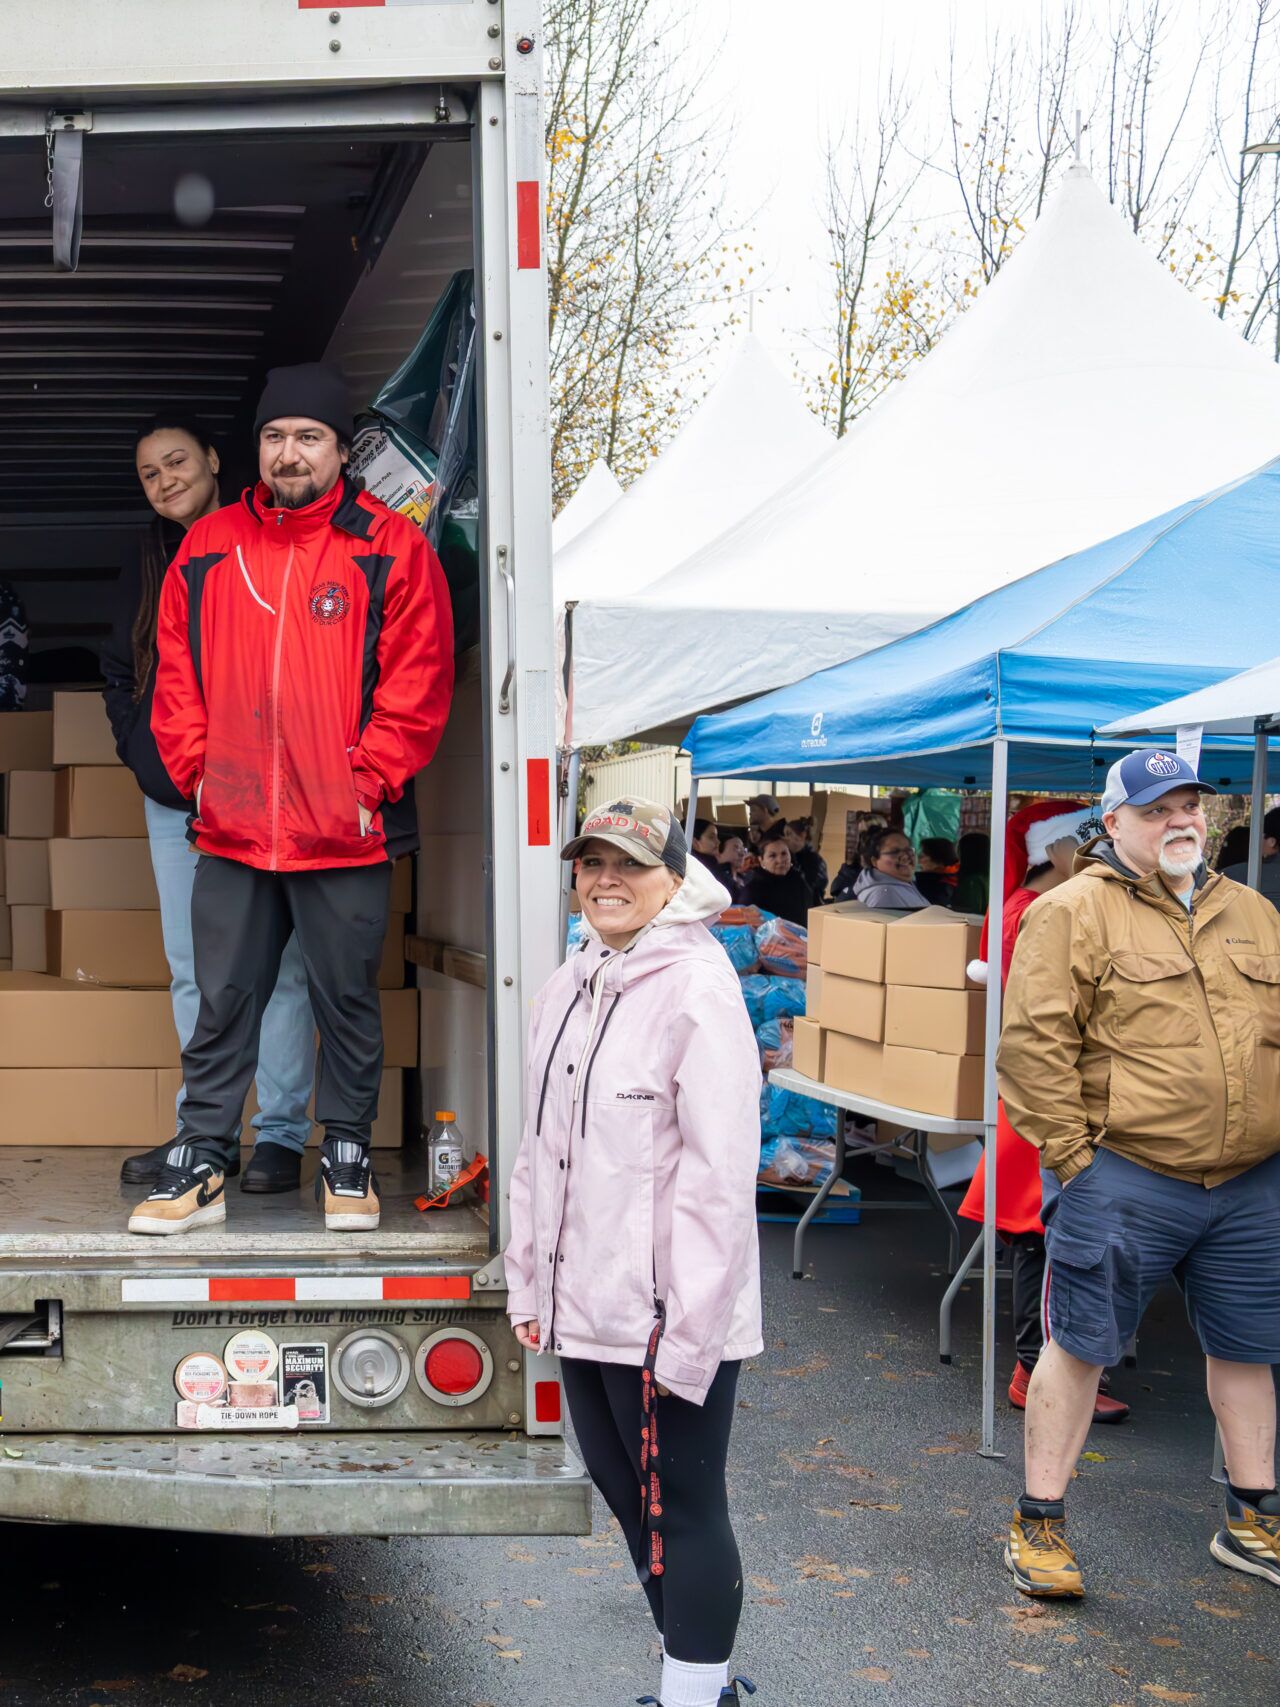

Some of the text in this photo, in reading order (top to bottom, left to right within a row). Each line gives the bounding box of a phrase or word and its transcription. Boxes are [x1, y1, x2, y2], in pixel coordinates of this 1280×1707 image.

[585, 815, 629, 832] ROAD
[616, 1093, 655, 1101] DAKINE
[172, 1310, 221, 1326] Don't
[228, 1310, 286, 1327] Forget
[293, 1309, 334, 1323] Your
[339, 1309, 407, 1325] Moving
[285, 1357, 324, 1365] MAXIMUM
[285, 1364, 324, 1372] SECURITY
[221, 1411, 279, 1420] TIE-DOWN ROPE
